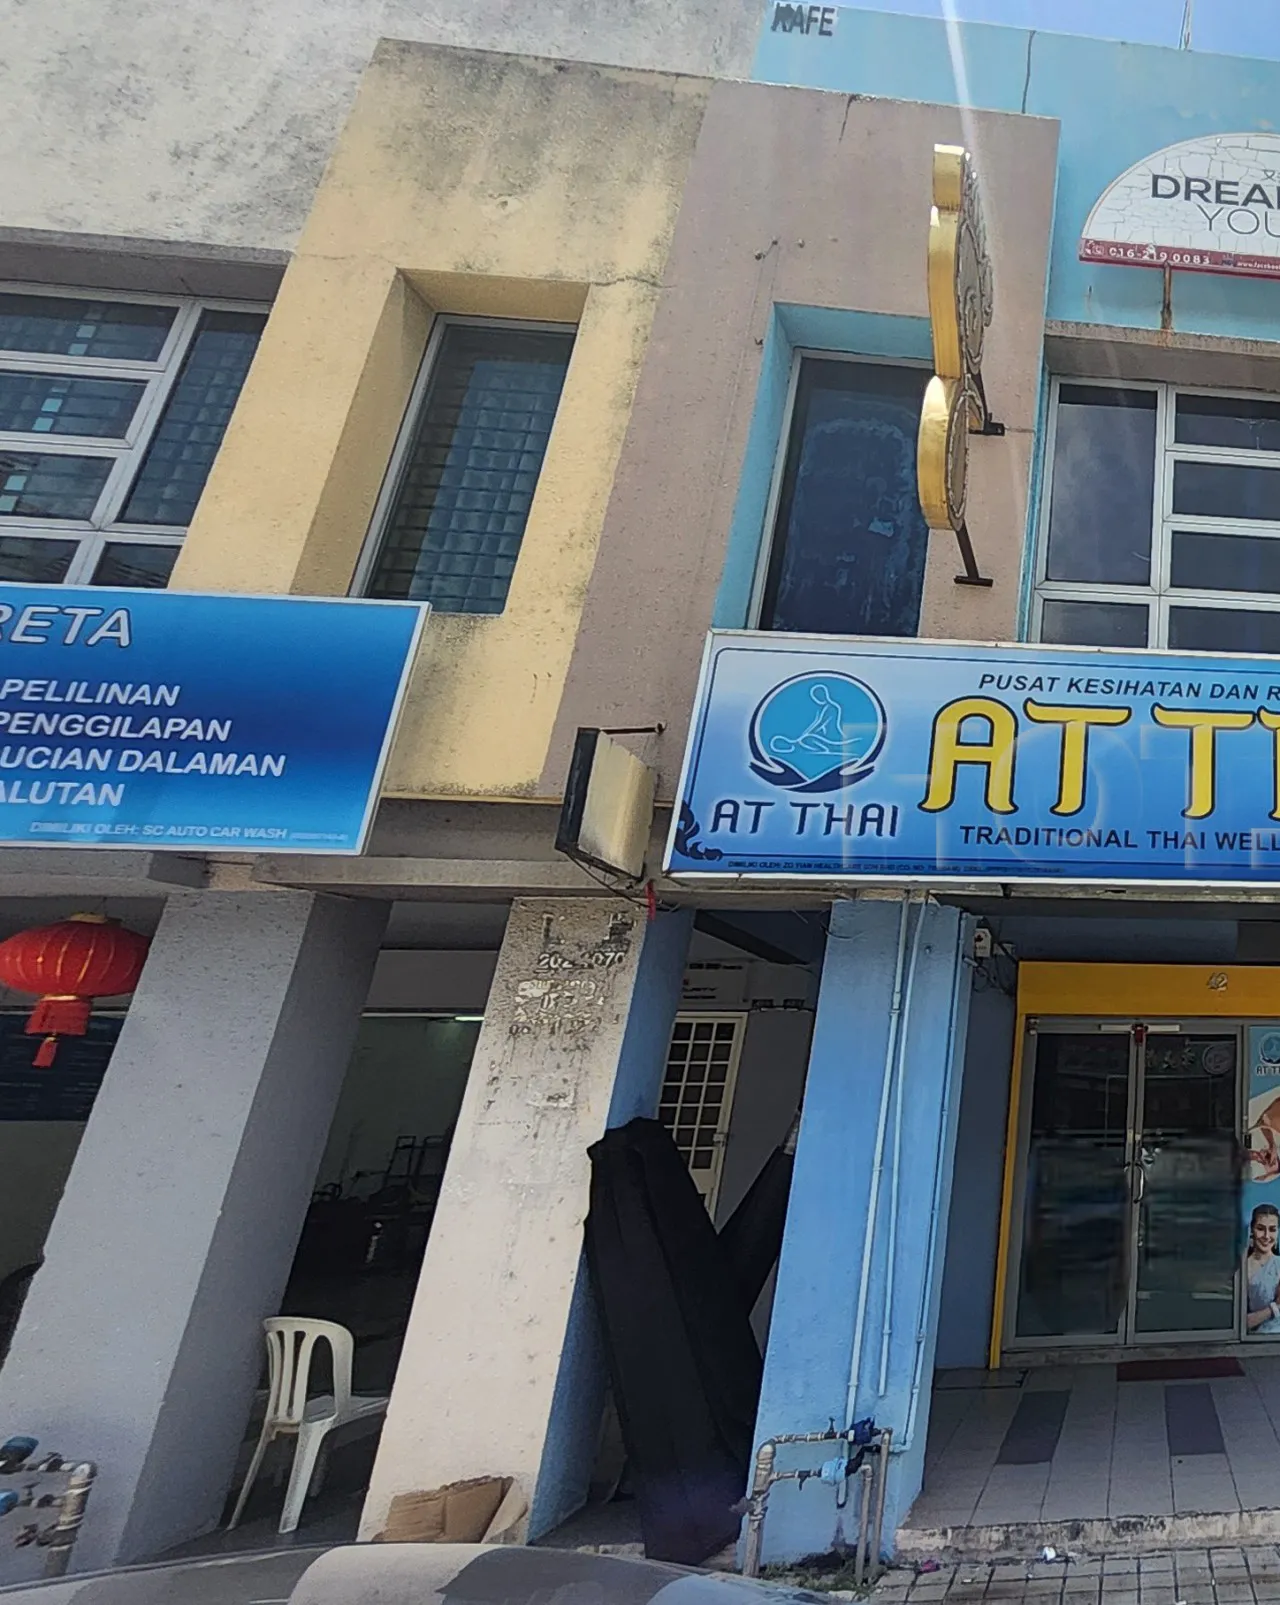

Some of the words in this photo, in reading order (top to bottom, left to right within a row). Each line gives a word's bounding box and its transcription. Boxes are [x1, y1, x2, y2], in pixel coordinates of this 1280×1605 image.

[1172, 255, 1210, 265] 0083
[1, 678, 180, 706] PELILINAN
[978, 673, 1060, 692] PUSAT
[1066, 677, 1203, 698] KESIHATAN
[1209, 683, 1259, 701] DAN
[117, 750, 287, 777] DALAMAN
[917, 695, 1132, 818] AT
[709, 798, 775, 834] AT
[789, 801, 899, 838] THAI
[168, 825, 209, 837] AUTO
[209, 826, 241, 838] CAR
[243, 827, 288, 839] WASH
[959, 825, 1138, 849] TRADITIONAL
[1146, 829, 1206, 851] THAI
